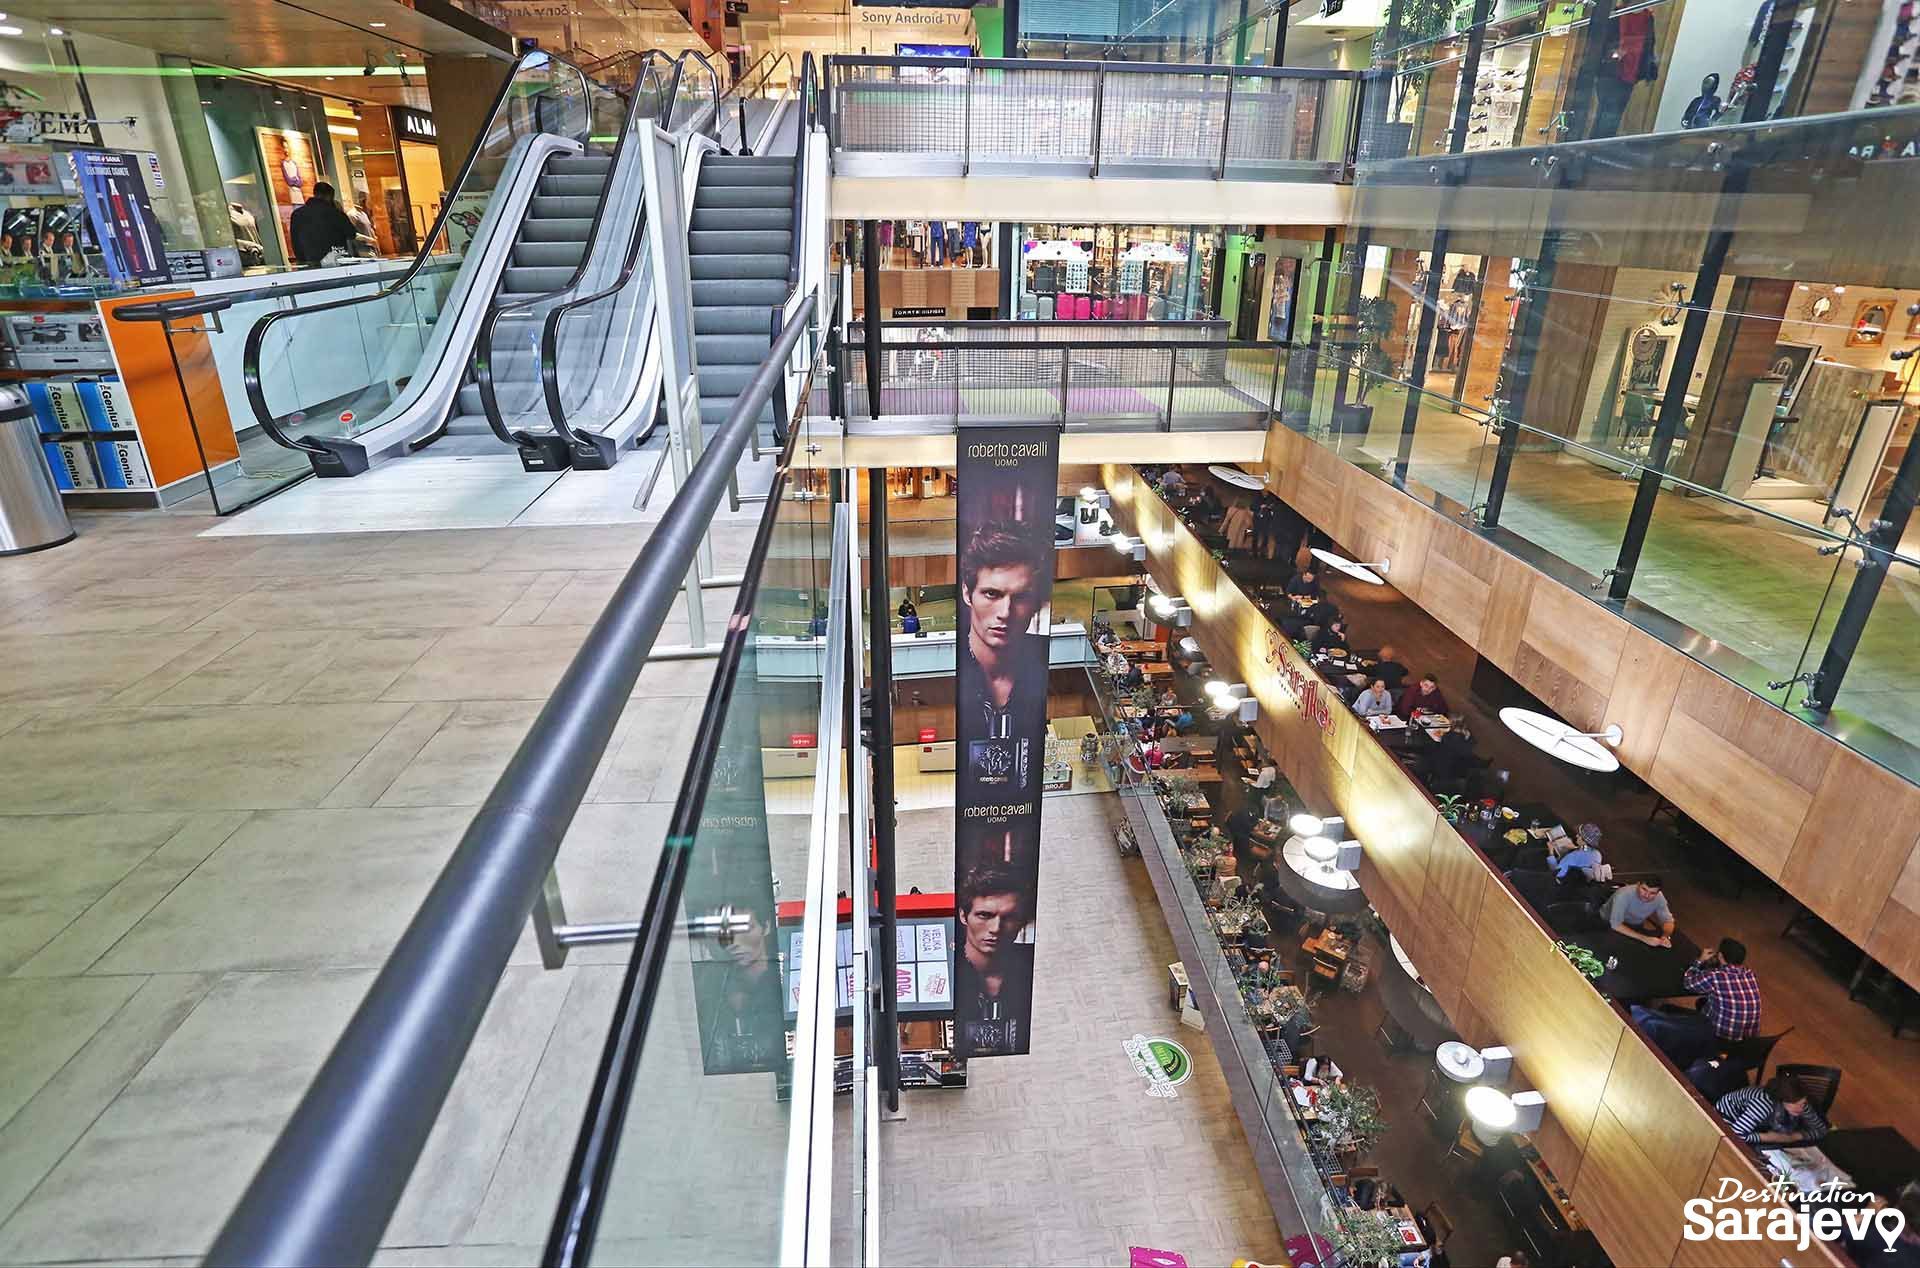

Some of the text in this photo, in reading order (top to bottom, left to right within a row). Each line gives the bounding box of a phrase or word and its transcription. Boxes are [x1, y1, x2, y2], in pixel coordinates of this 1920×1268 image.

[861, 11, 961, 25] Sony Android TV
[968, 441, 1048, 458] roberto cavalli
[964, 802, 1033, 818] roberto cavalli
[987, 816, 1007, 824] UOMO
